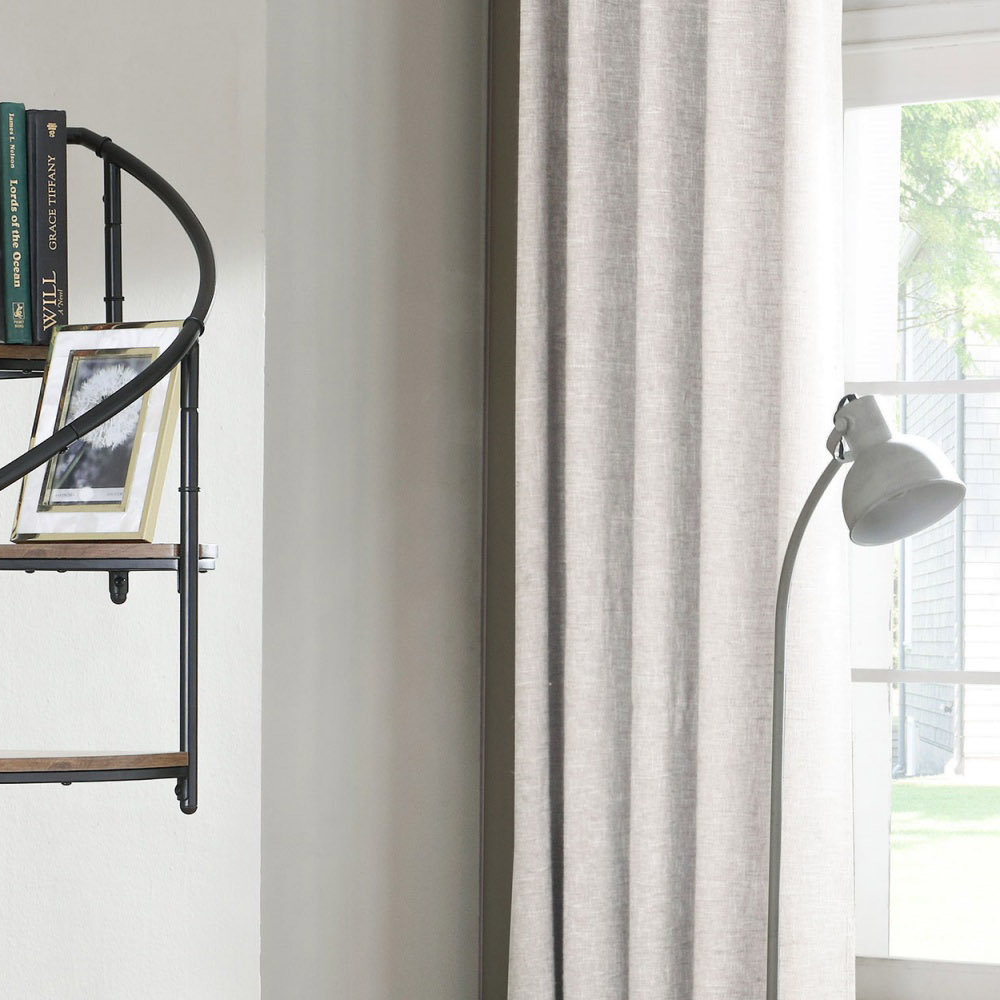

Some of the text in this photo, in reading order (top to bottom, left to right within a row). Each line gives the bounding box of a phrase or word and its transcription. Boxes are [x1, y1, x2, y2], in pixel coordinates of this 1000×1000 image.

[9, 179, 22, 288] Lords of the Ocean
[47, 155, 57, 251] GRACE TIFFANY
[42, 270, 57, 332] WILL
